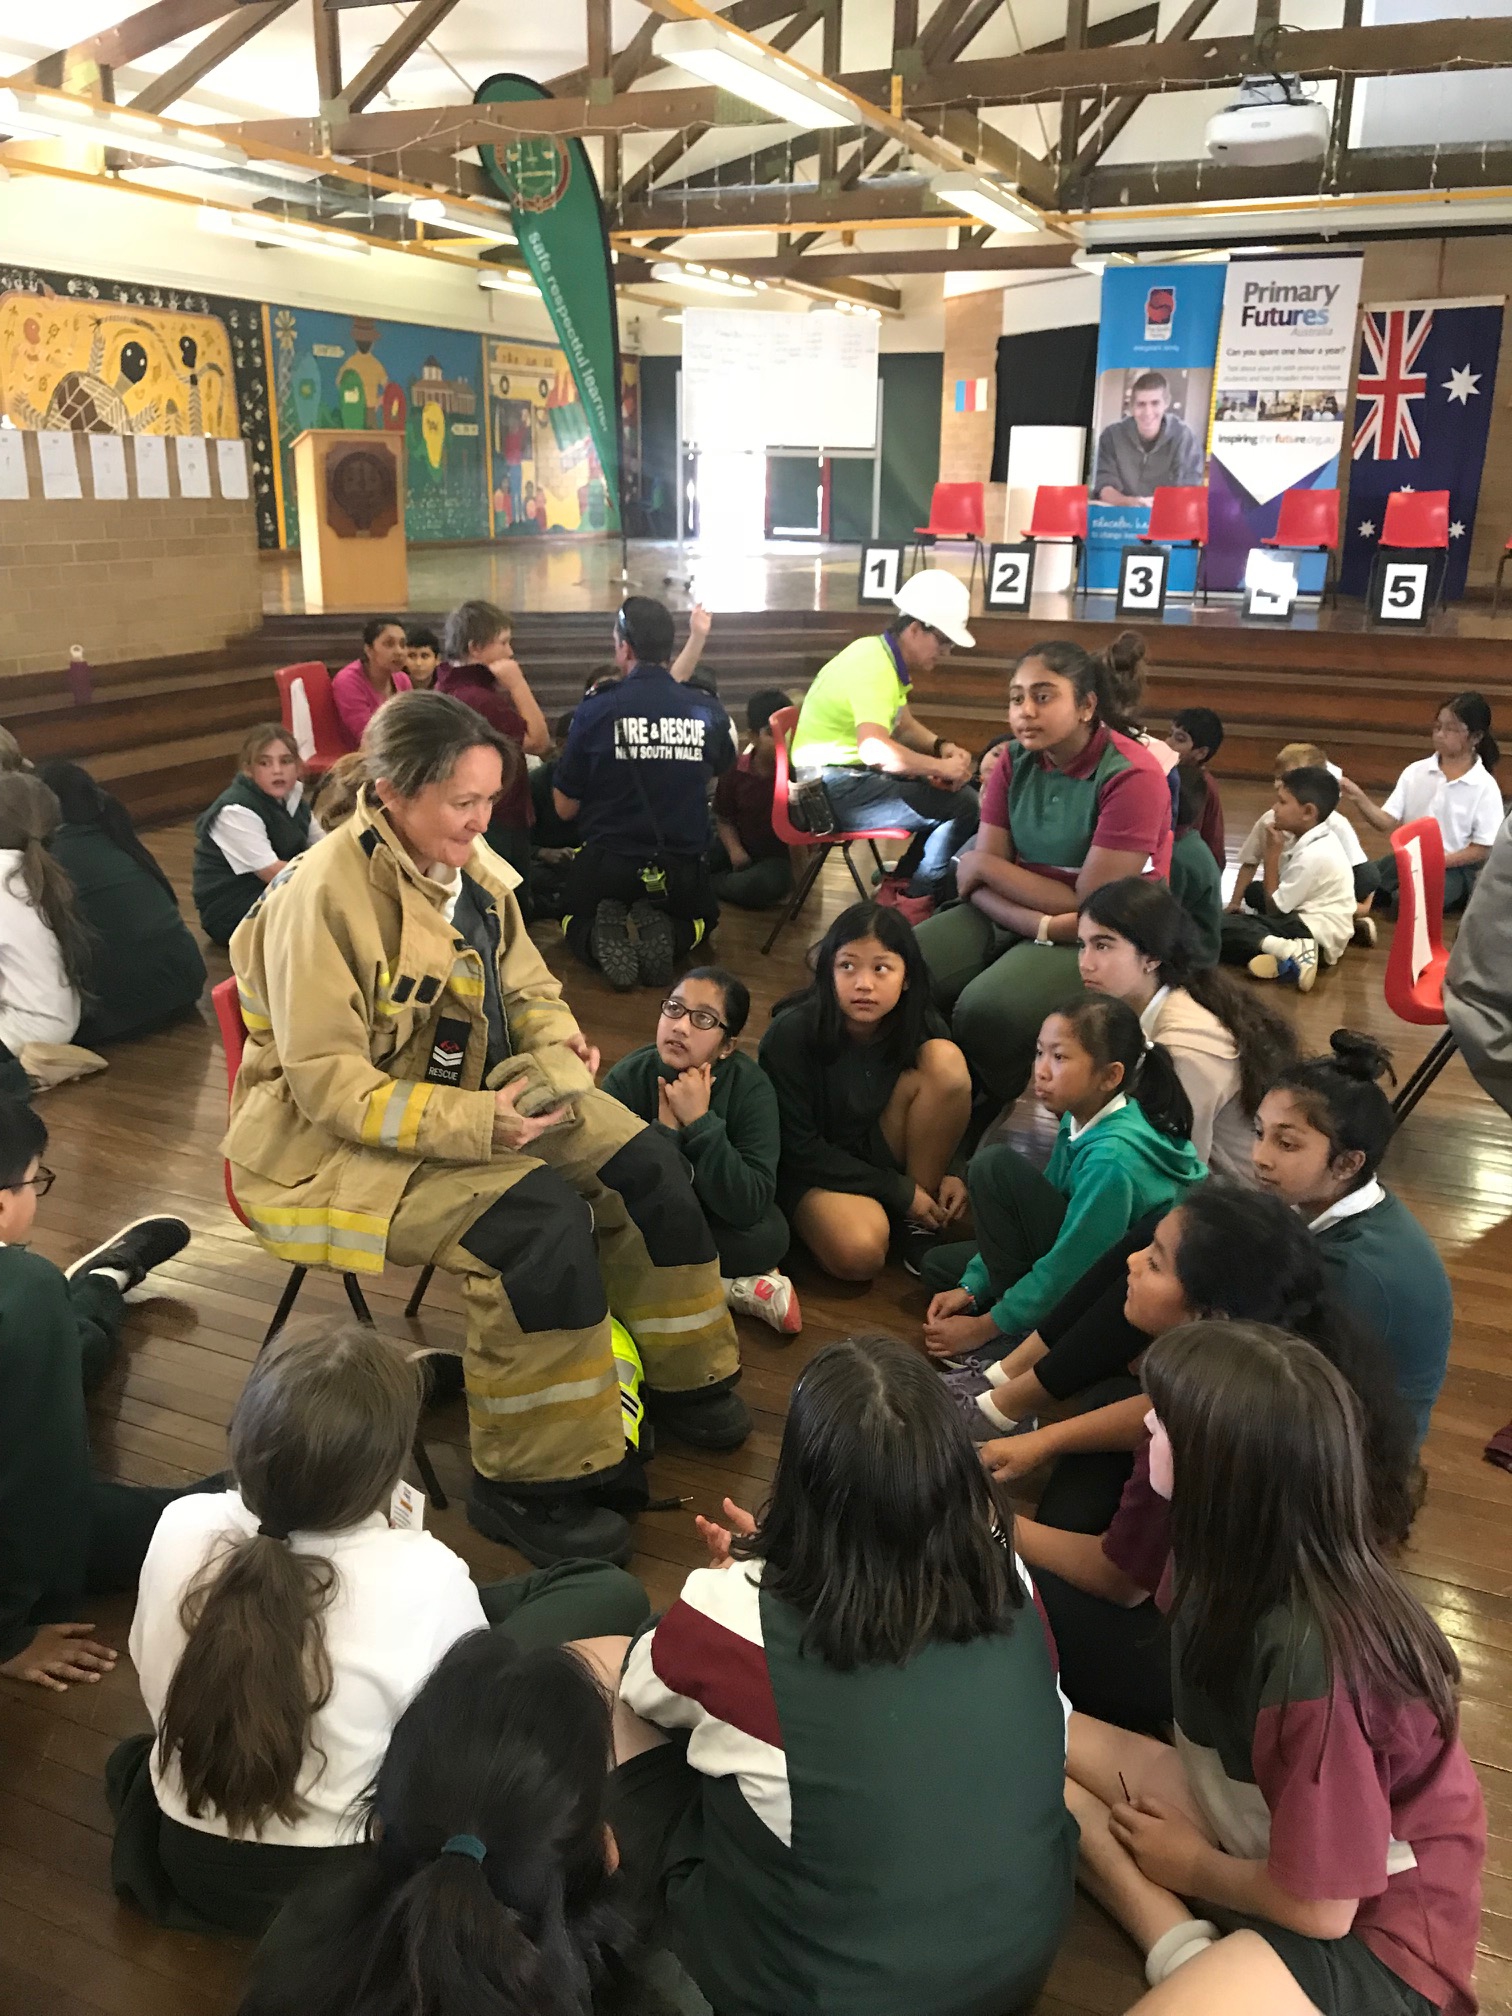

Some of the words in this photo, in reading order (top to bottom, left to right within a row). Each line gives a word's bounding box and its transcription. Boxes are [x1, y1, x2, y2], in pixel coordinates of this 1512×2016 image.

[528, 231, 552, 273] safe
[547, 275, 590, 368] respectful
[1243, 281, 1340, 306] Primary
[1241, 305, 1330, 327] Futures
[1226, 348, 1241, 356] Can
[1243, 349, 1257, 358] you
[1259, 348, 1279, 357] spare
[1281, 348, 1296, 356] one
[1298, 346, 1315, 356] hour
[1325, 346, 1347, 357] year?
[870, 558, 887, 588] 1
[995, 563, 1021, 593] 2
[1129, 566, 1154, 598] 3
[1387, 575, 1416, 607] 5
[614, 717, 649, 745] FIRE
[650, 722, 660, 740] &
[660, 717, 705, 747] RESCUE
[640, 745, 672, 760] SOUTH
[674, 746, 703, 761] WALES
[430, 1067, 458, 1081] RESCUE
